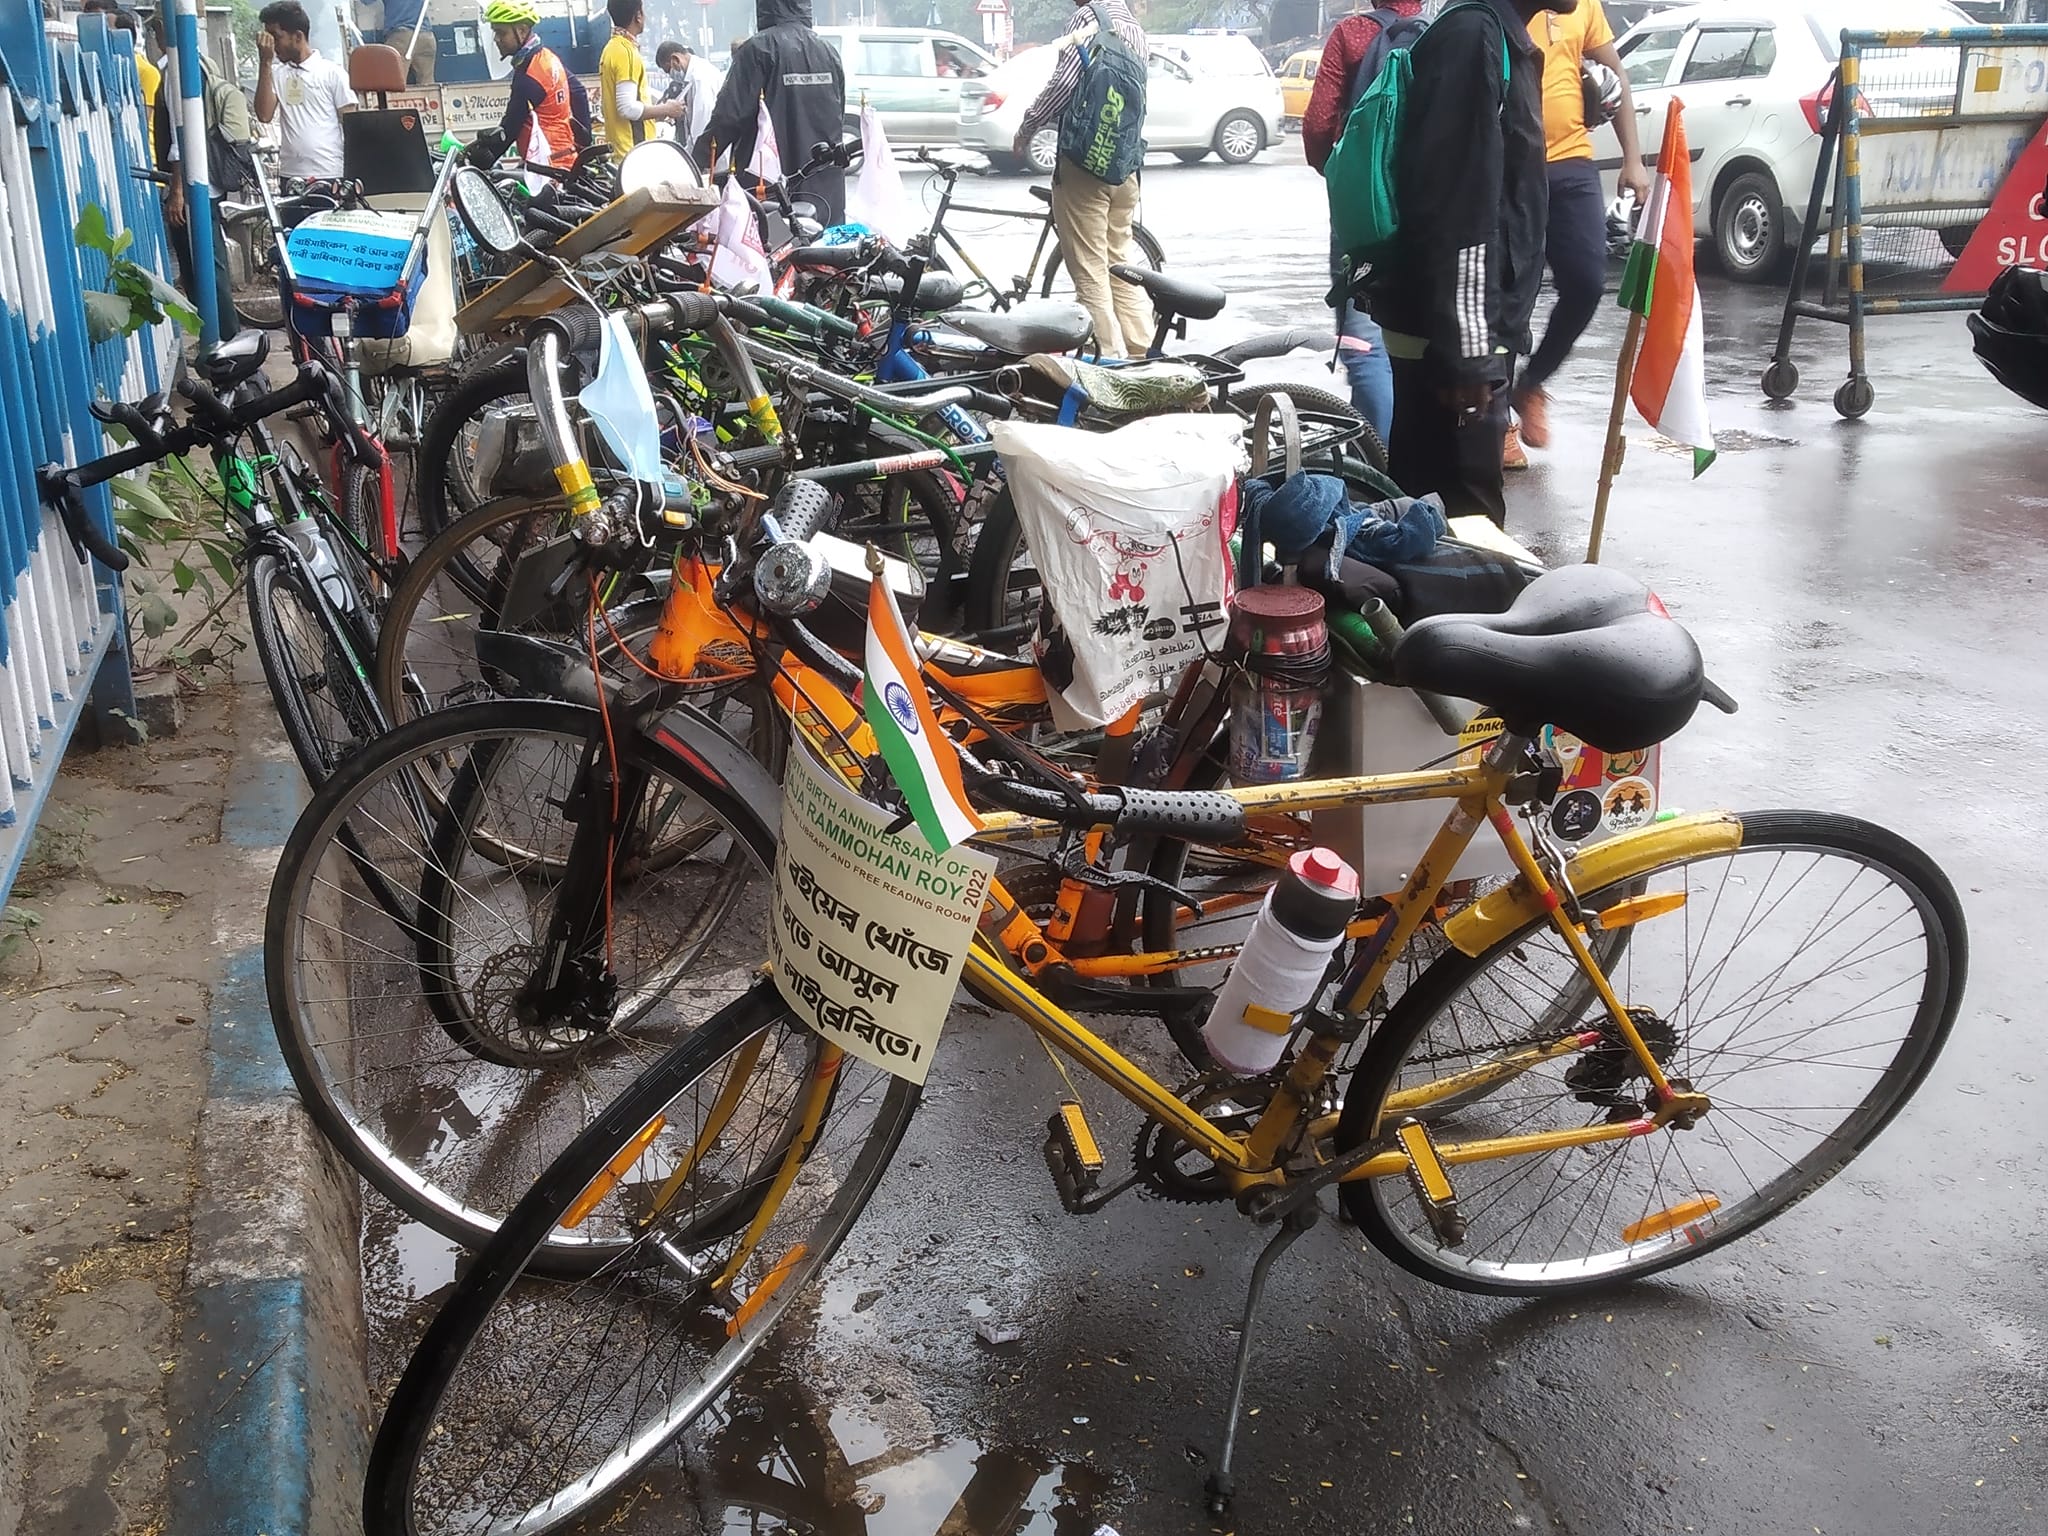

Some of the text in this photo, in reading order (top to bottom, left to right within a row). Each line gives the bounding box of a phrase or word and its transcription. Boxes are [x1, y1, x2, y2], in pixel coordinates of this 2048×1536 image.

[470, 95, 511, 108] Welcom
[1093, 127, 1122, 177] CRAFT
[806, 778, 838, 814] BIRTH
[838, 809, 944, 868] ANNIVERSARY
[947, 861, 970, 878] OF
[807, 801, 912, 881] RAMMOHAN
[915, 869, 965, 901] ROY
[799, 823, 830, 857] LIBRARY
[830, 851, 851, 870] AND
[852, 865, 881, 886] FREE
[882, 882, 933, 910] READING
[935, 904, 972, 924] ROOM
[962, 868, 988, 910] 2022
[817, 940, 900, 1004] আসুন
[864, 919, 953, 976] খোঁজে
